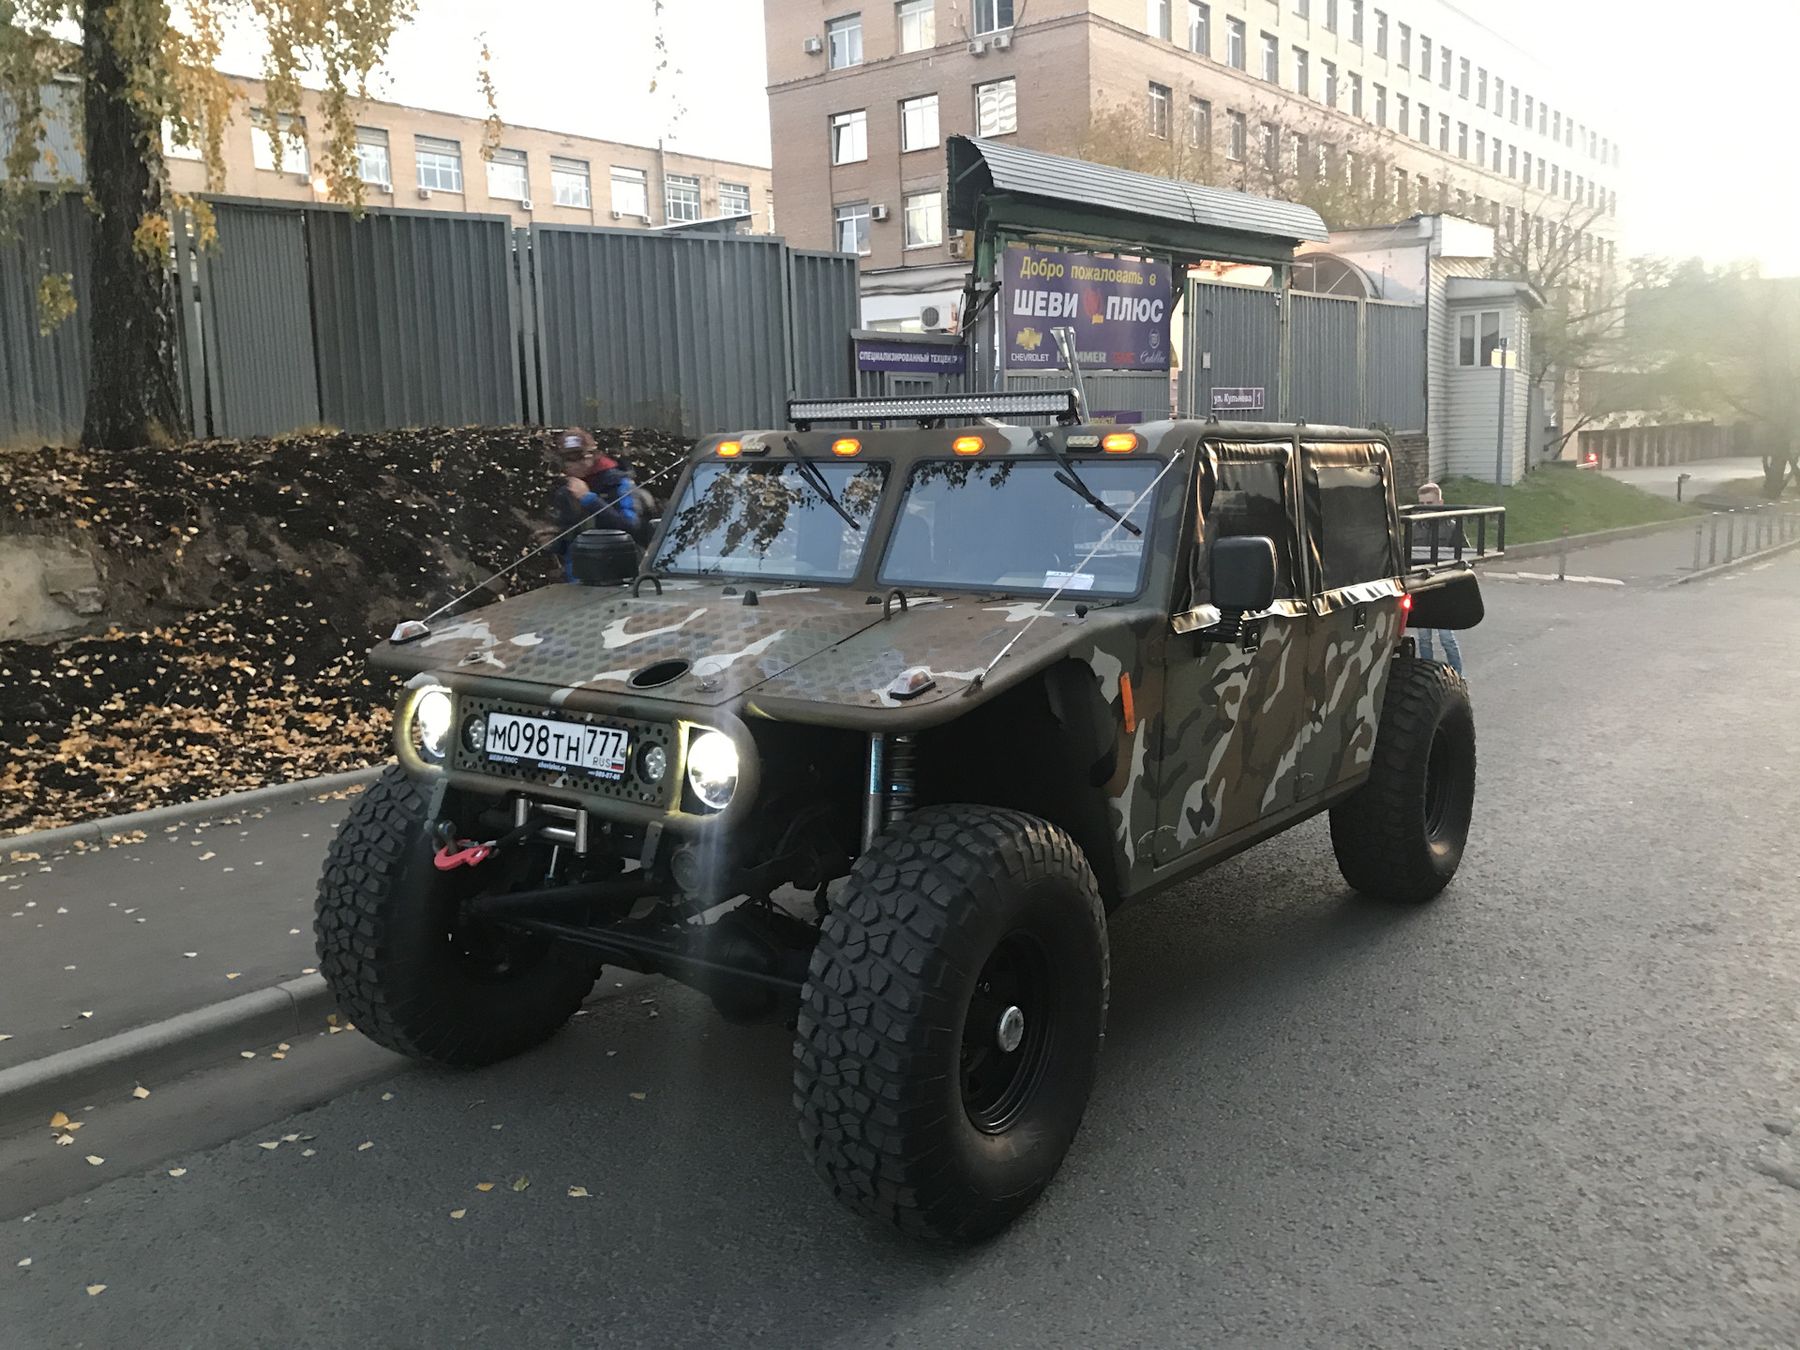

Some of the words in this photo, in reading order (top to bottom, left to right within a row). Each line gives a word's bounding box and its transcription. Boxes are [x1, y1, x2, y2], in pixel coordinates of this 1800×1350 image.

[1020, 256, 1064, 281] Добро
[1071, 265, 1143, 285] пожаловать
[1149, 273, 1157, 286] в
[1013, 289, 1079, 318] ШЕВИ
[1106, 295, 1164, 323] ПЛЮС
[860, 351, 929, 363] СПЕЦИАЛИЗИРОВАННЫЙ
[1011, 353, 1049, 362] CHEVROLET
[1057, 351, 1106, 363] HMMER
[587, 729, 622, 758] 777
[592, 756, 611, 767] RUS
